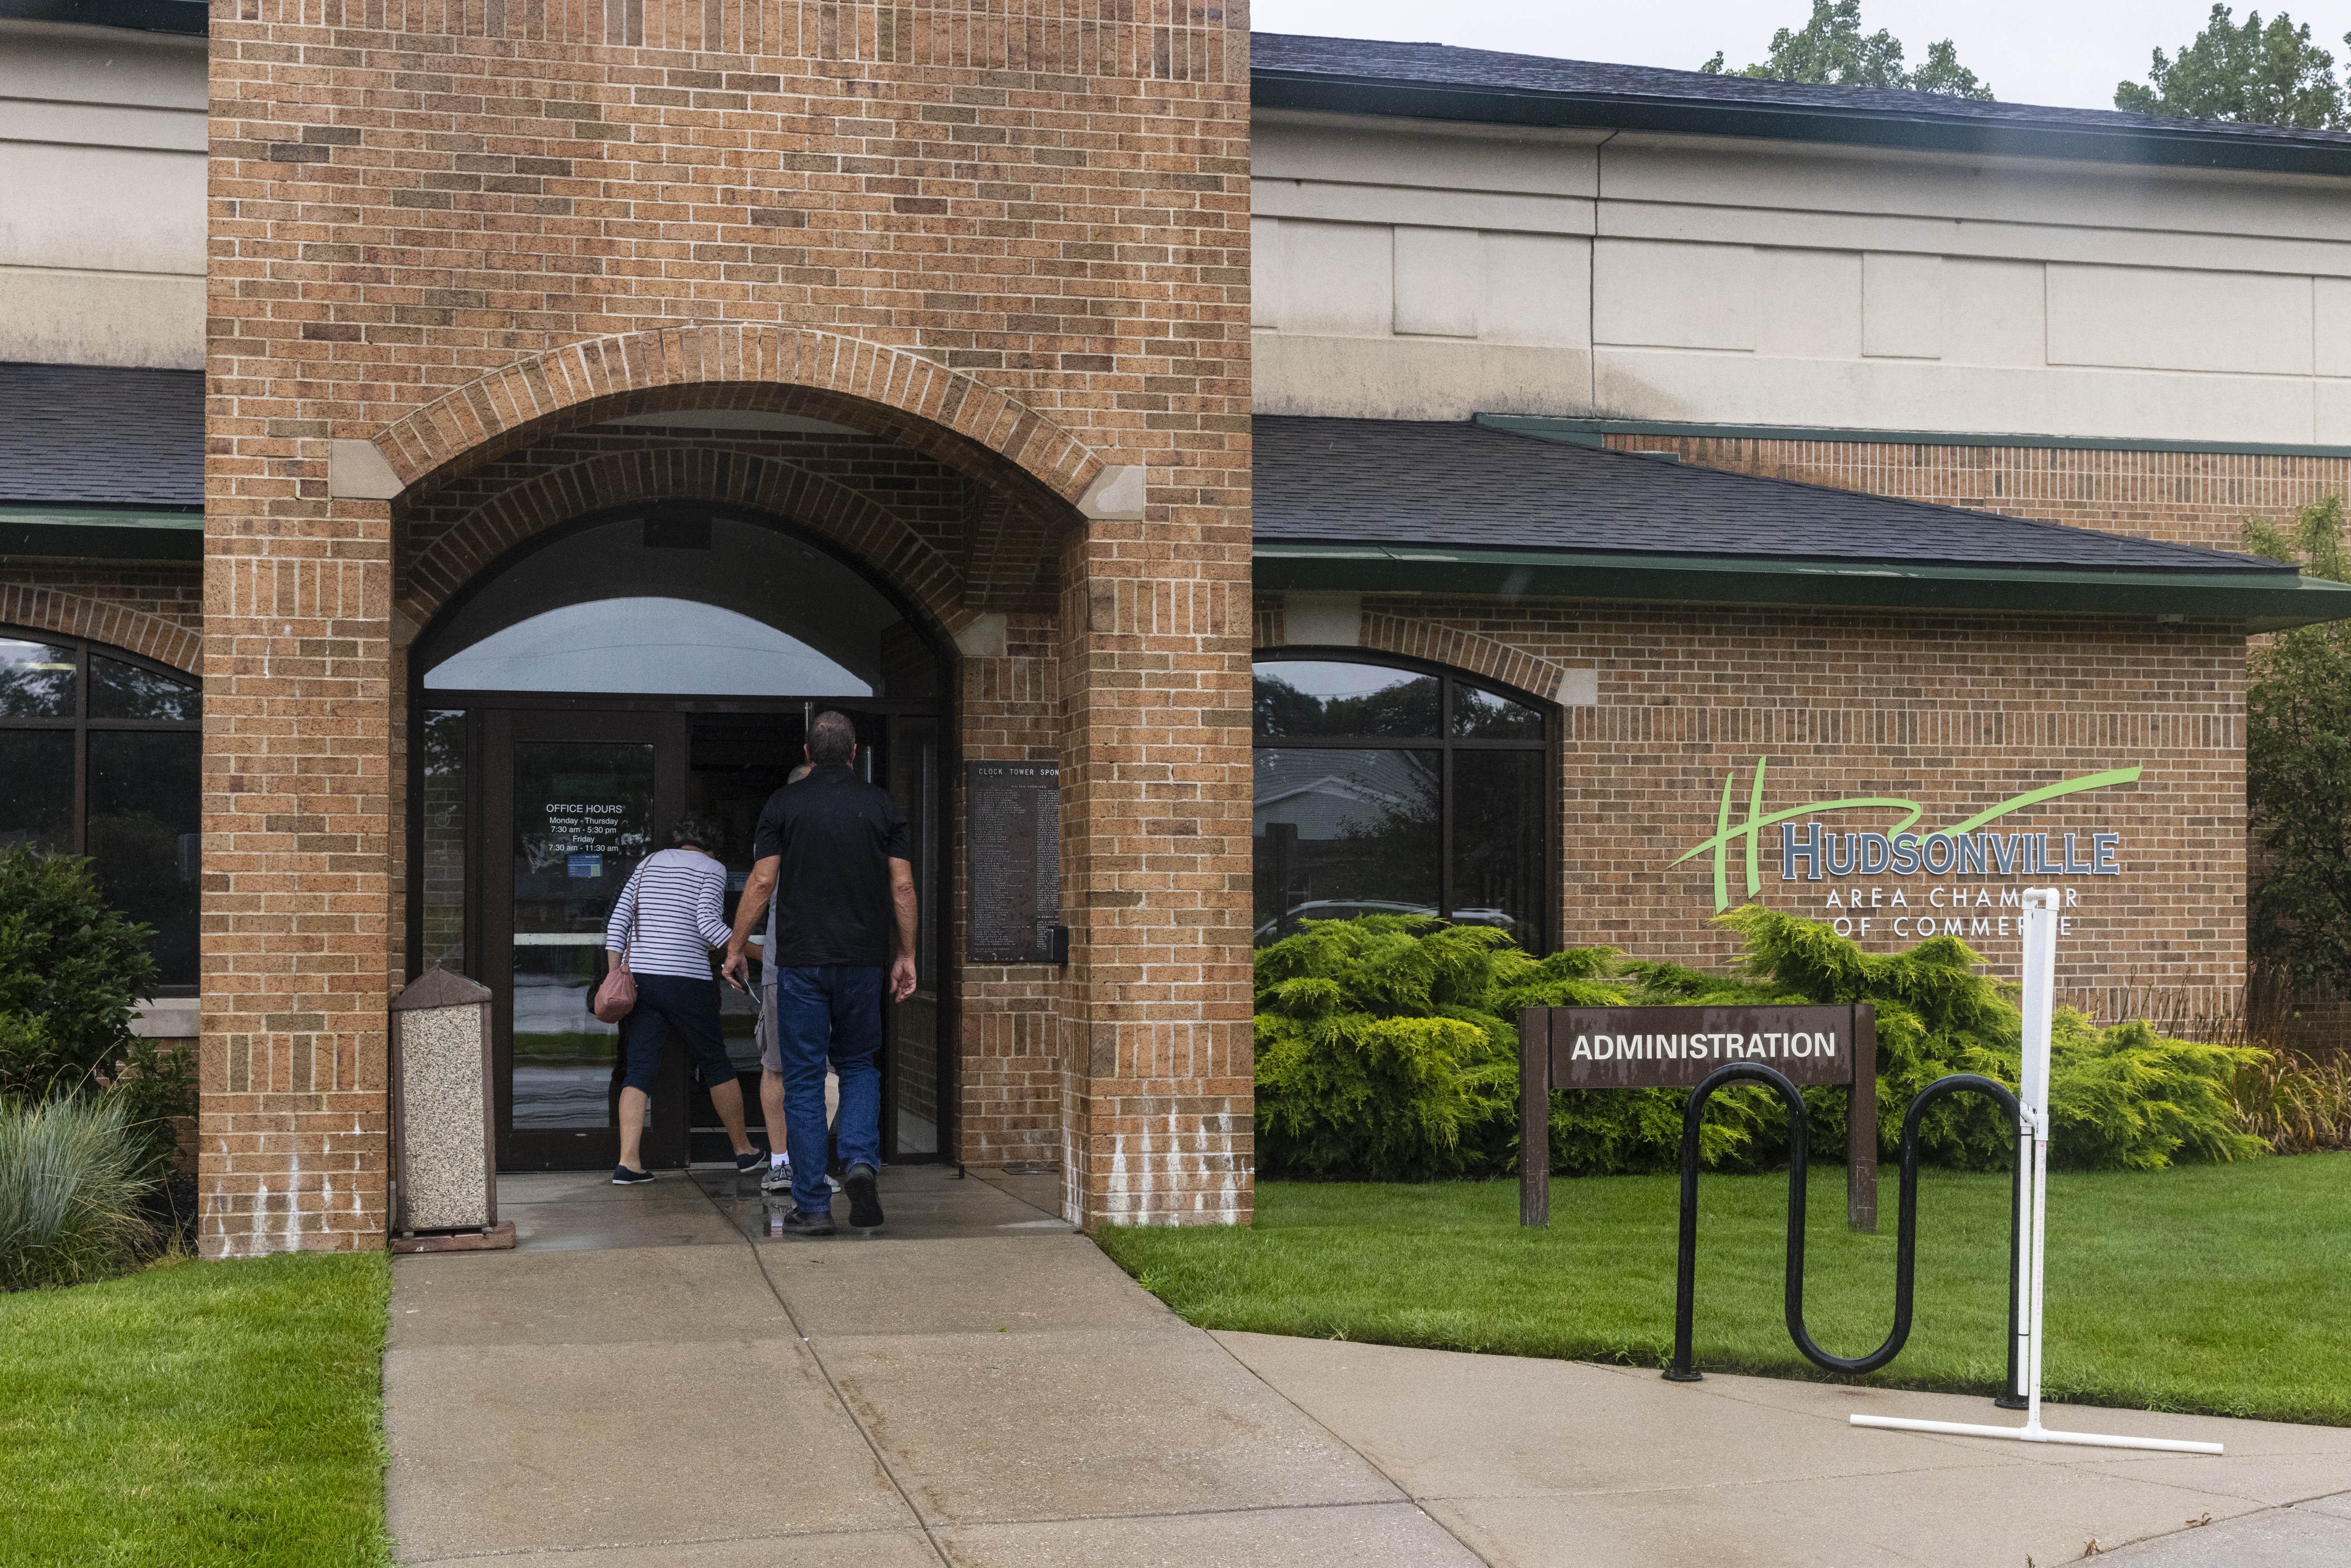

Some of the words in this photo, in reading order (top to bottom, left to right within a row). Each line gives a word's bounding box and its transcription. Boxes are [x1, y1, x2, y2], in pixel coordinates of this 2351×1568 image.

[546, 804, 583, 813] OFFICE
[586, 805, 622, 813] HOURS
[550, 817, 578, 826] Monday
[585, 817, 618, 826] Thursday
[573, 835, 595, 844] Friday
[1782, 823, 2120, 881] HUDSONVILLE
[1826, 887, 1908, 908] AREA
[1930, 887, 2077, 908] CHAMR
[1834, 916, 1871, 937] OF
[1894, 916, 2071, 937] COMMERE
[1571, 1032, 1835, 1061] ADMINISTRATION
